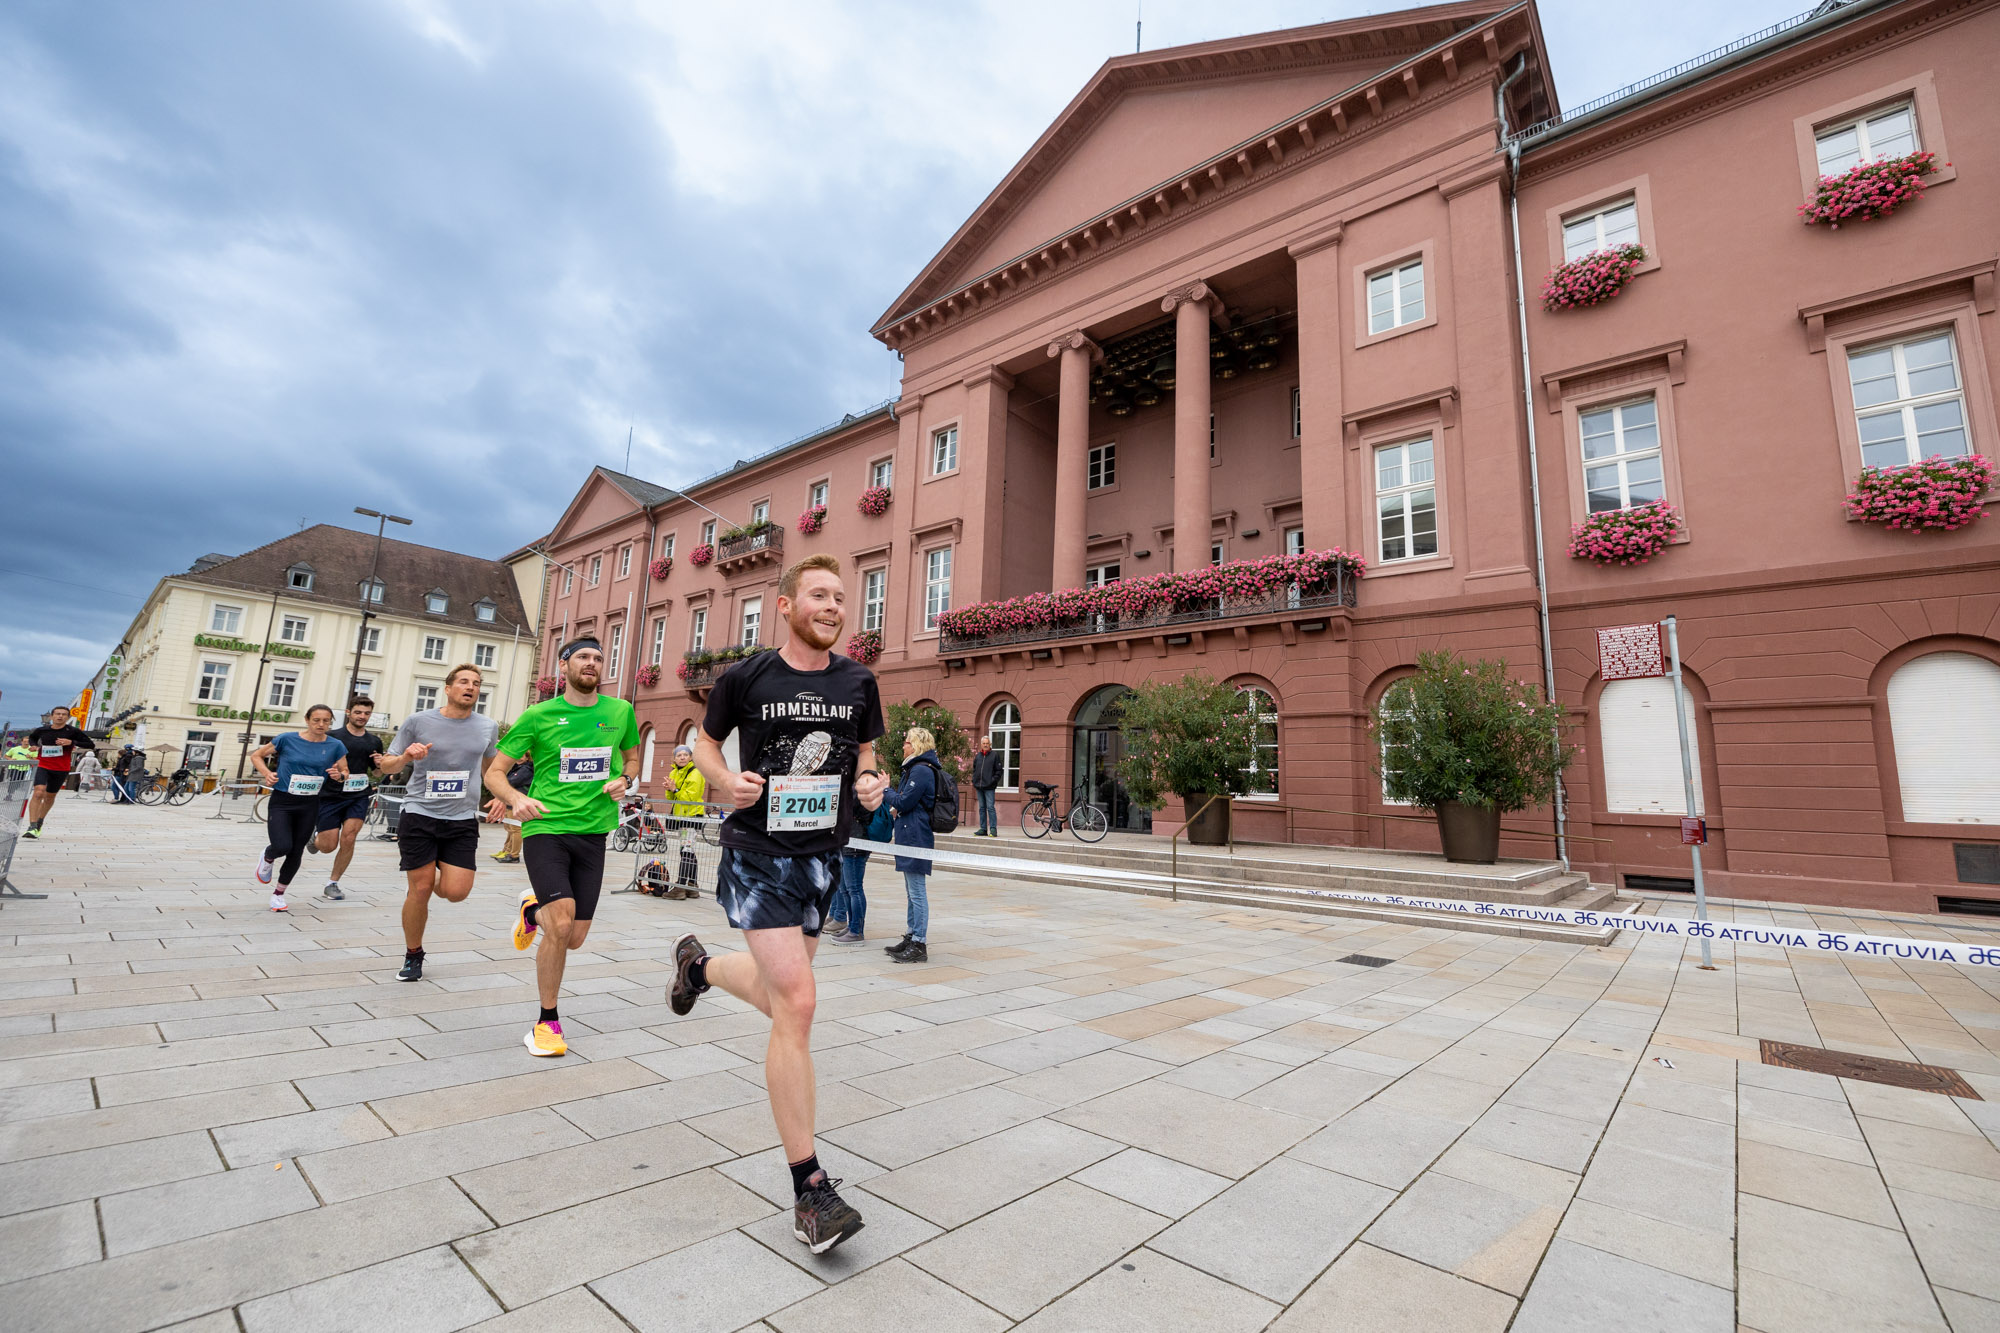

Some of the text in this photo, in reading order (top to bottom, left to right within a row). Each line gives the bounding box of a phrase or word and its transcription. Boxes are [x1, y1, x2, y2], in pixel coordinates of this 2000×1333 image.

[194, 632, 315, 659] Hoepfner Pilsner
[101, 655, 121, 712] HOTEL
[196, 704, 292, 723] Kaiserhof
[761, 702, 853, 721] FIRMENLAUF
[575, 761, 598, 771] 425
[437, 782, 458, 791] 547
[785, 797, 826, 813] 2704
[1409, 900, 1468, 912] ATRUVIA
[1500, 908, 1567, 922] ATRUVIA
[1602, 917, 1679, 934] ATRUVIA
[1719, 927, 1807, 947] ATRUVIA
[1854, 940, 1957, 962] ATRUVIA
